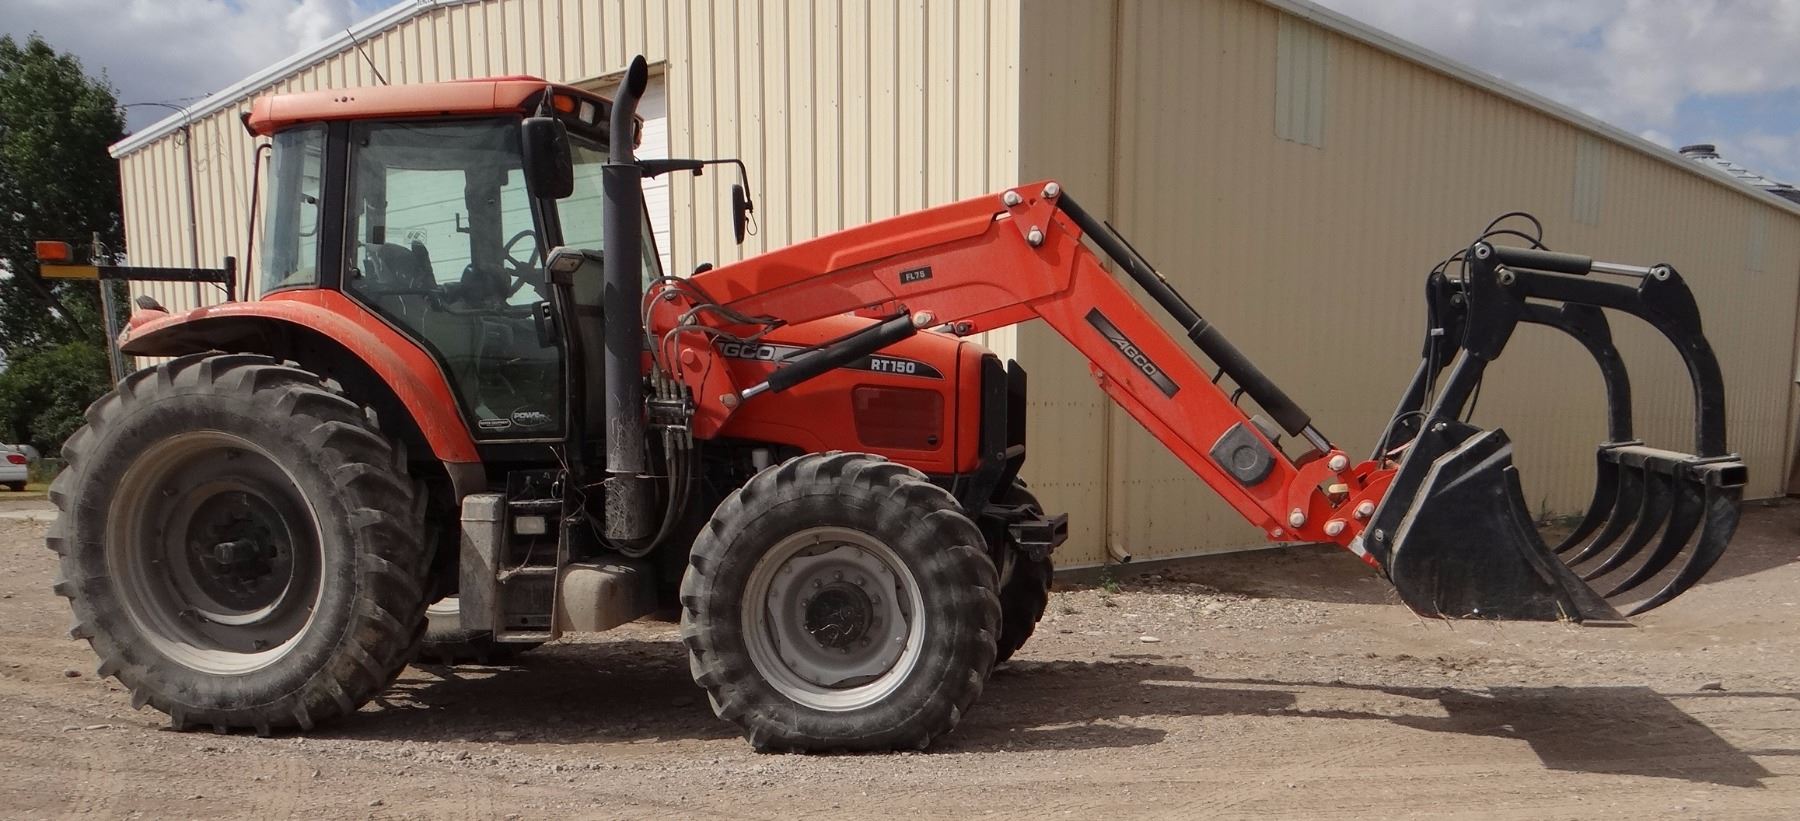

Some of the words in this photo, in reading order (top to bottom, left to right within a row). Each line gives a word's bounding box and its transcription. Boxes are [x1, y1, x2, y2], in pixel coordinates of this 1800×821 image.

[905, 270, 926, 281] FL75
[1111, 338, 1157, 376] AGCO
[871, 358, 916, 374] RT150
